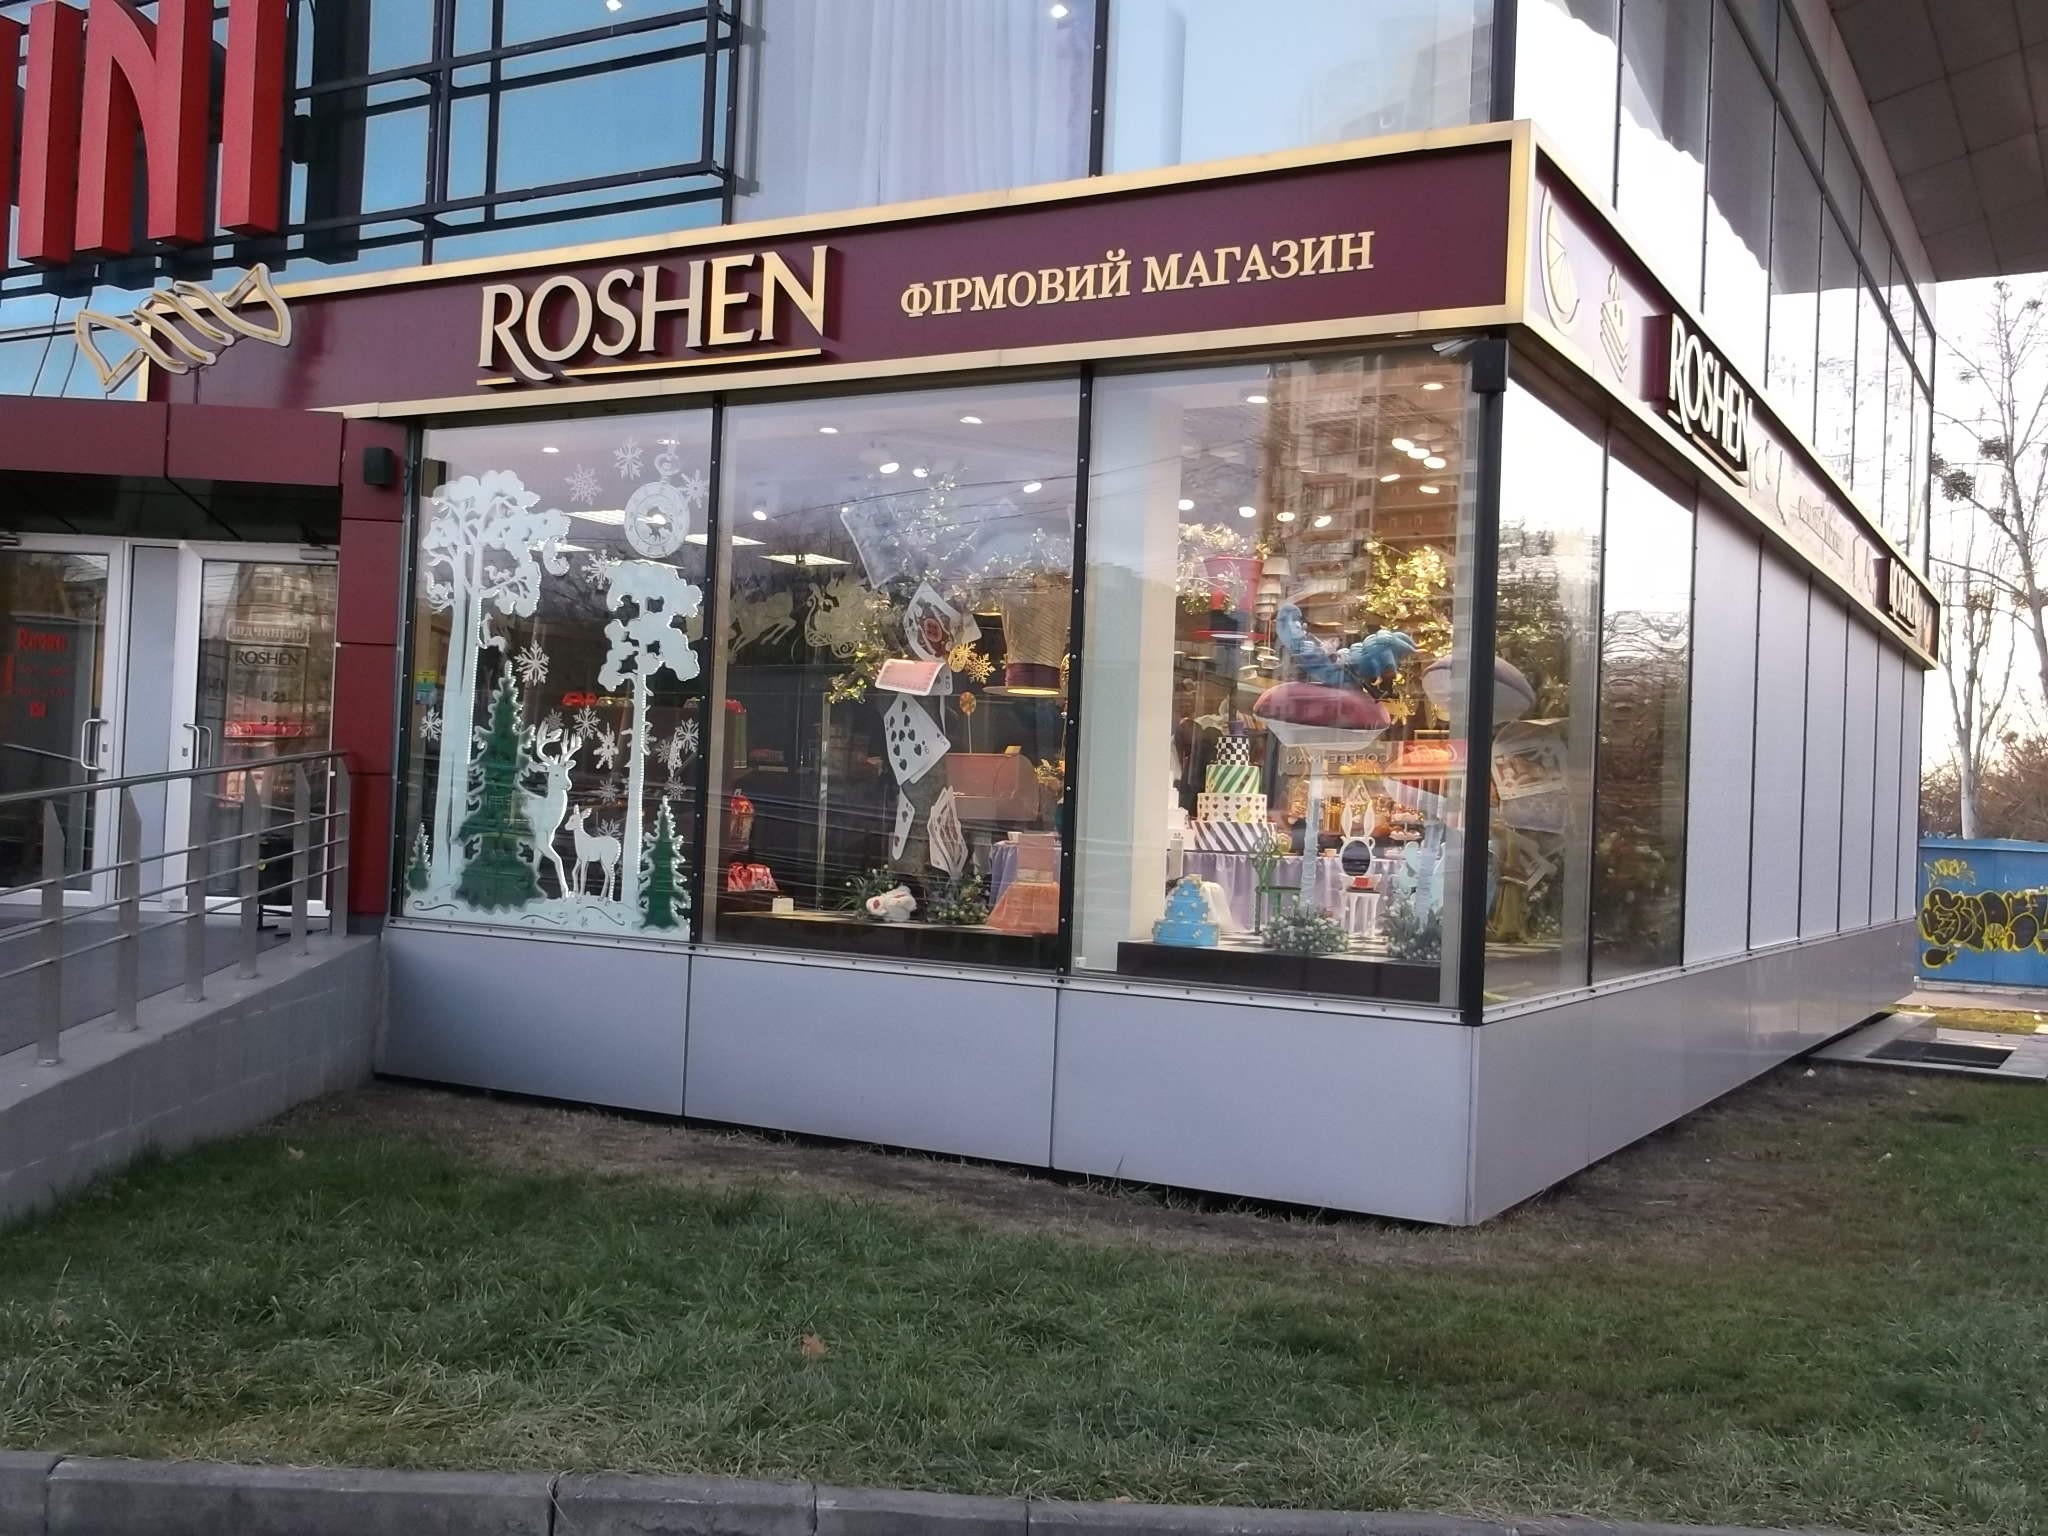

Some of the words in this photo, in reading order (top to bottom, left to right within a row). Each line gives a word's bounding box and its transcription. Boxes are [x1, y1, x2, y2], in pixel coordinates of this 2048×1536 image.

[0, 0, 285, 270] INI
[478, 245, 829, 381] ROSHEN
[901, 248, 1132, 318] ФІРМОВИЙ
[1142, 230, 1376, 293] МАГАЗИН
[1668, 313, 1753, 473] ROSHEN
[235, 650, 302, 667] ROSHEN
